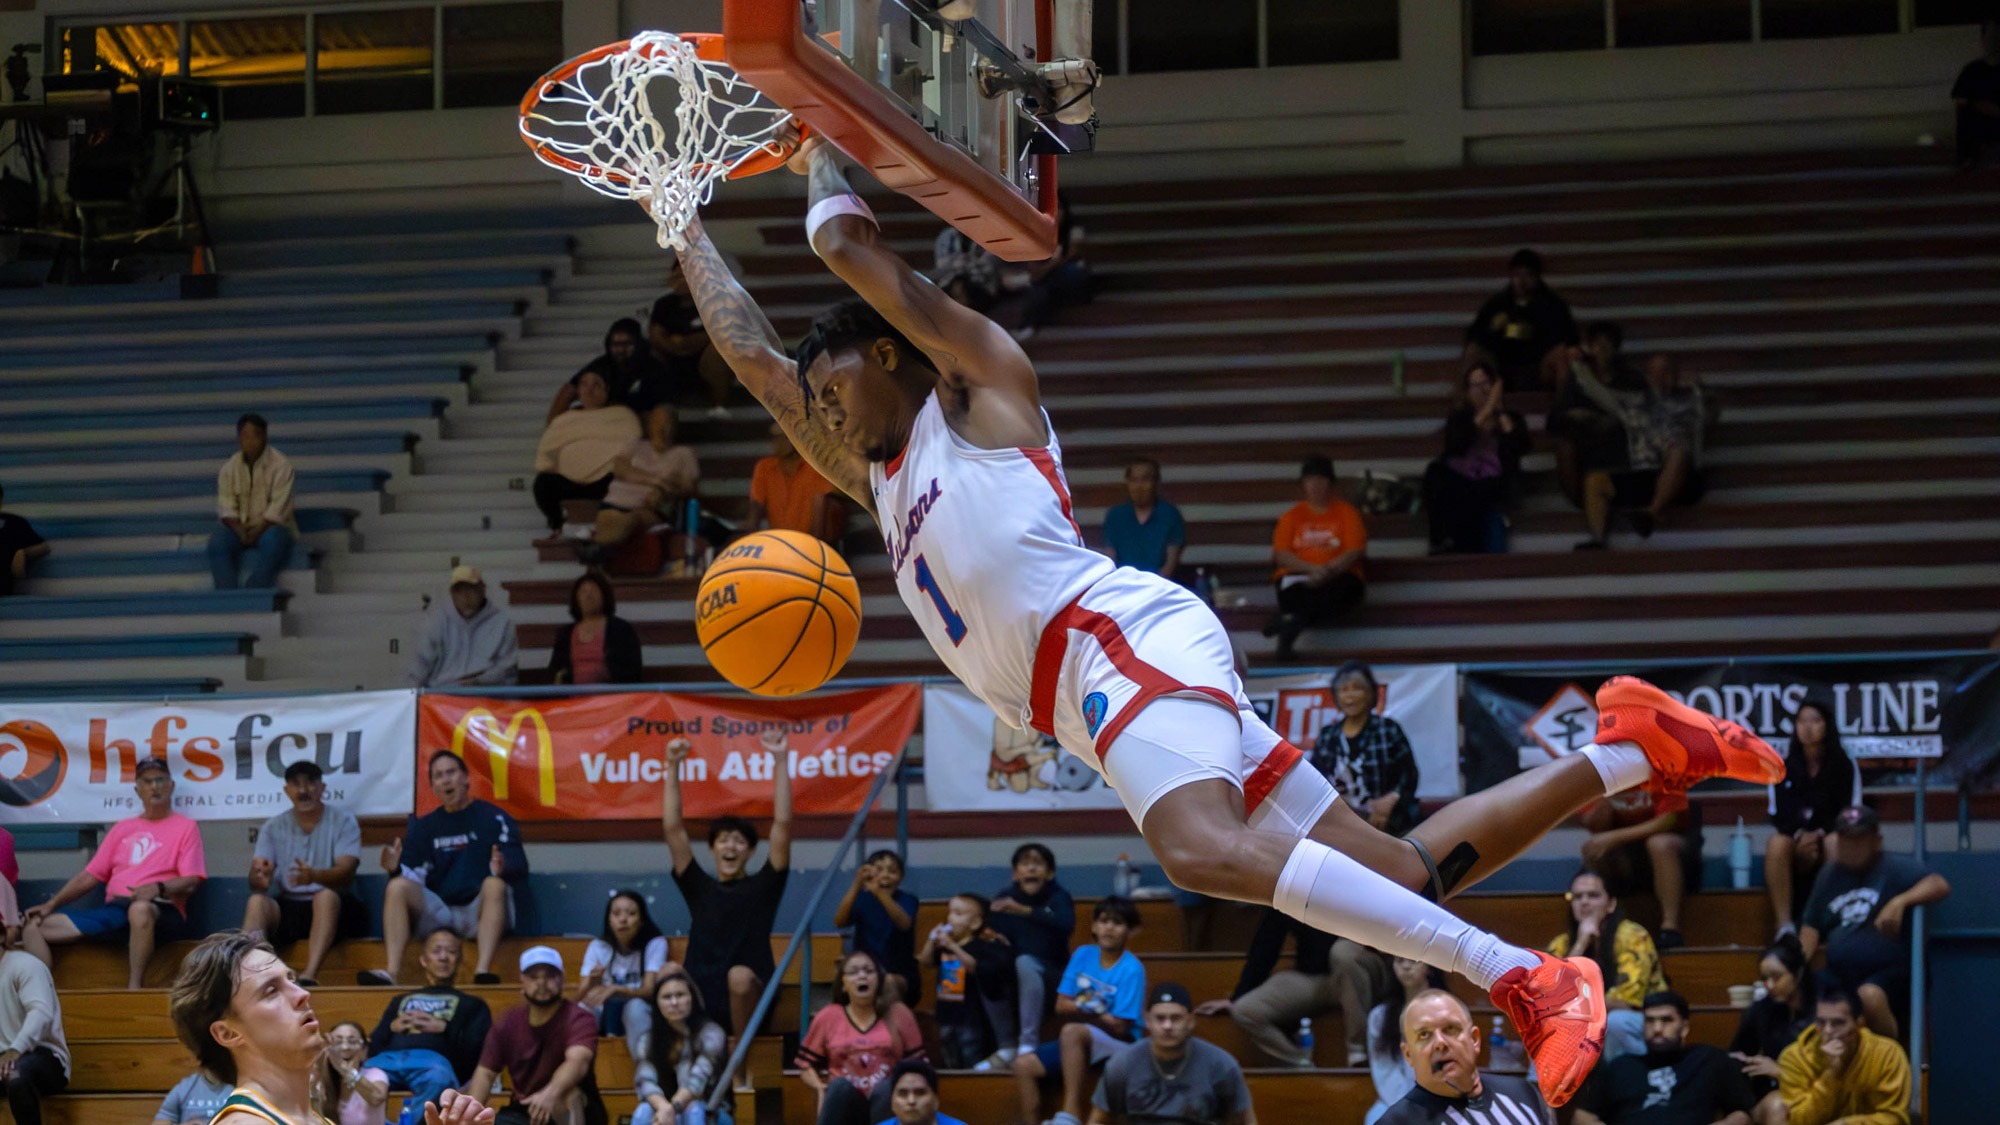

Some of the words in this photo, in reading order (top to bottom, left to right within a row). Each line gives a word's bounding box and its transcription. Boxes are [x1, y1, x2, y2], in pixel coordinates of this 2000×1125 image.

[698, 583, 739, 620] CAA
[914, 552, 969, 648] 1
[627, 716, 702, 735] Proud
[825, 714, 852, 733] of
[1664, 682, 1808, 735] ORTS
[1832, 680, 1942, 734] LINE
[88, 713, 363, 784] hfsfcu
[103, 797, 134, 810] HFS
[174, 795, 217, 808] ERAL
[224, 792, 282, 806] CREDIT
